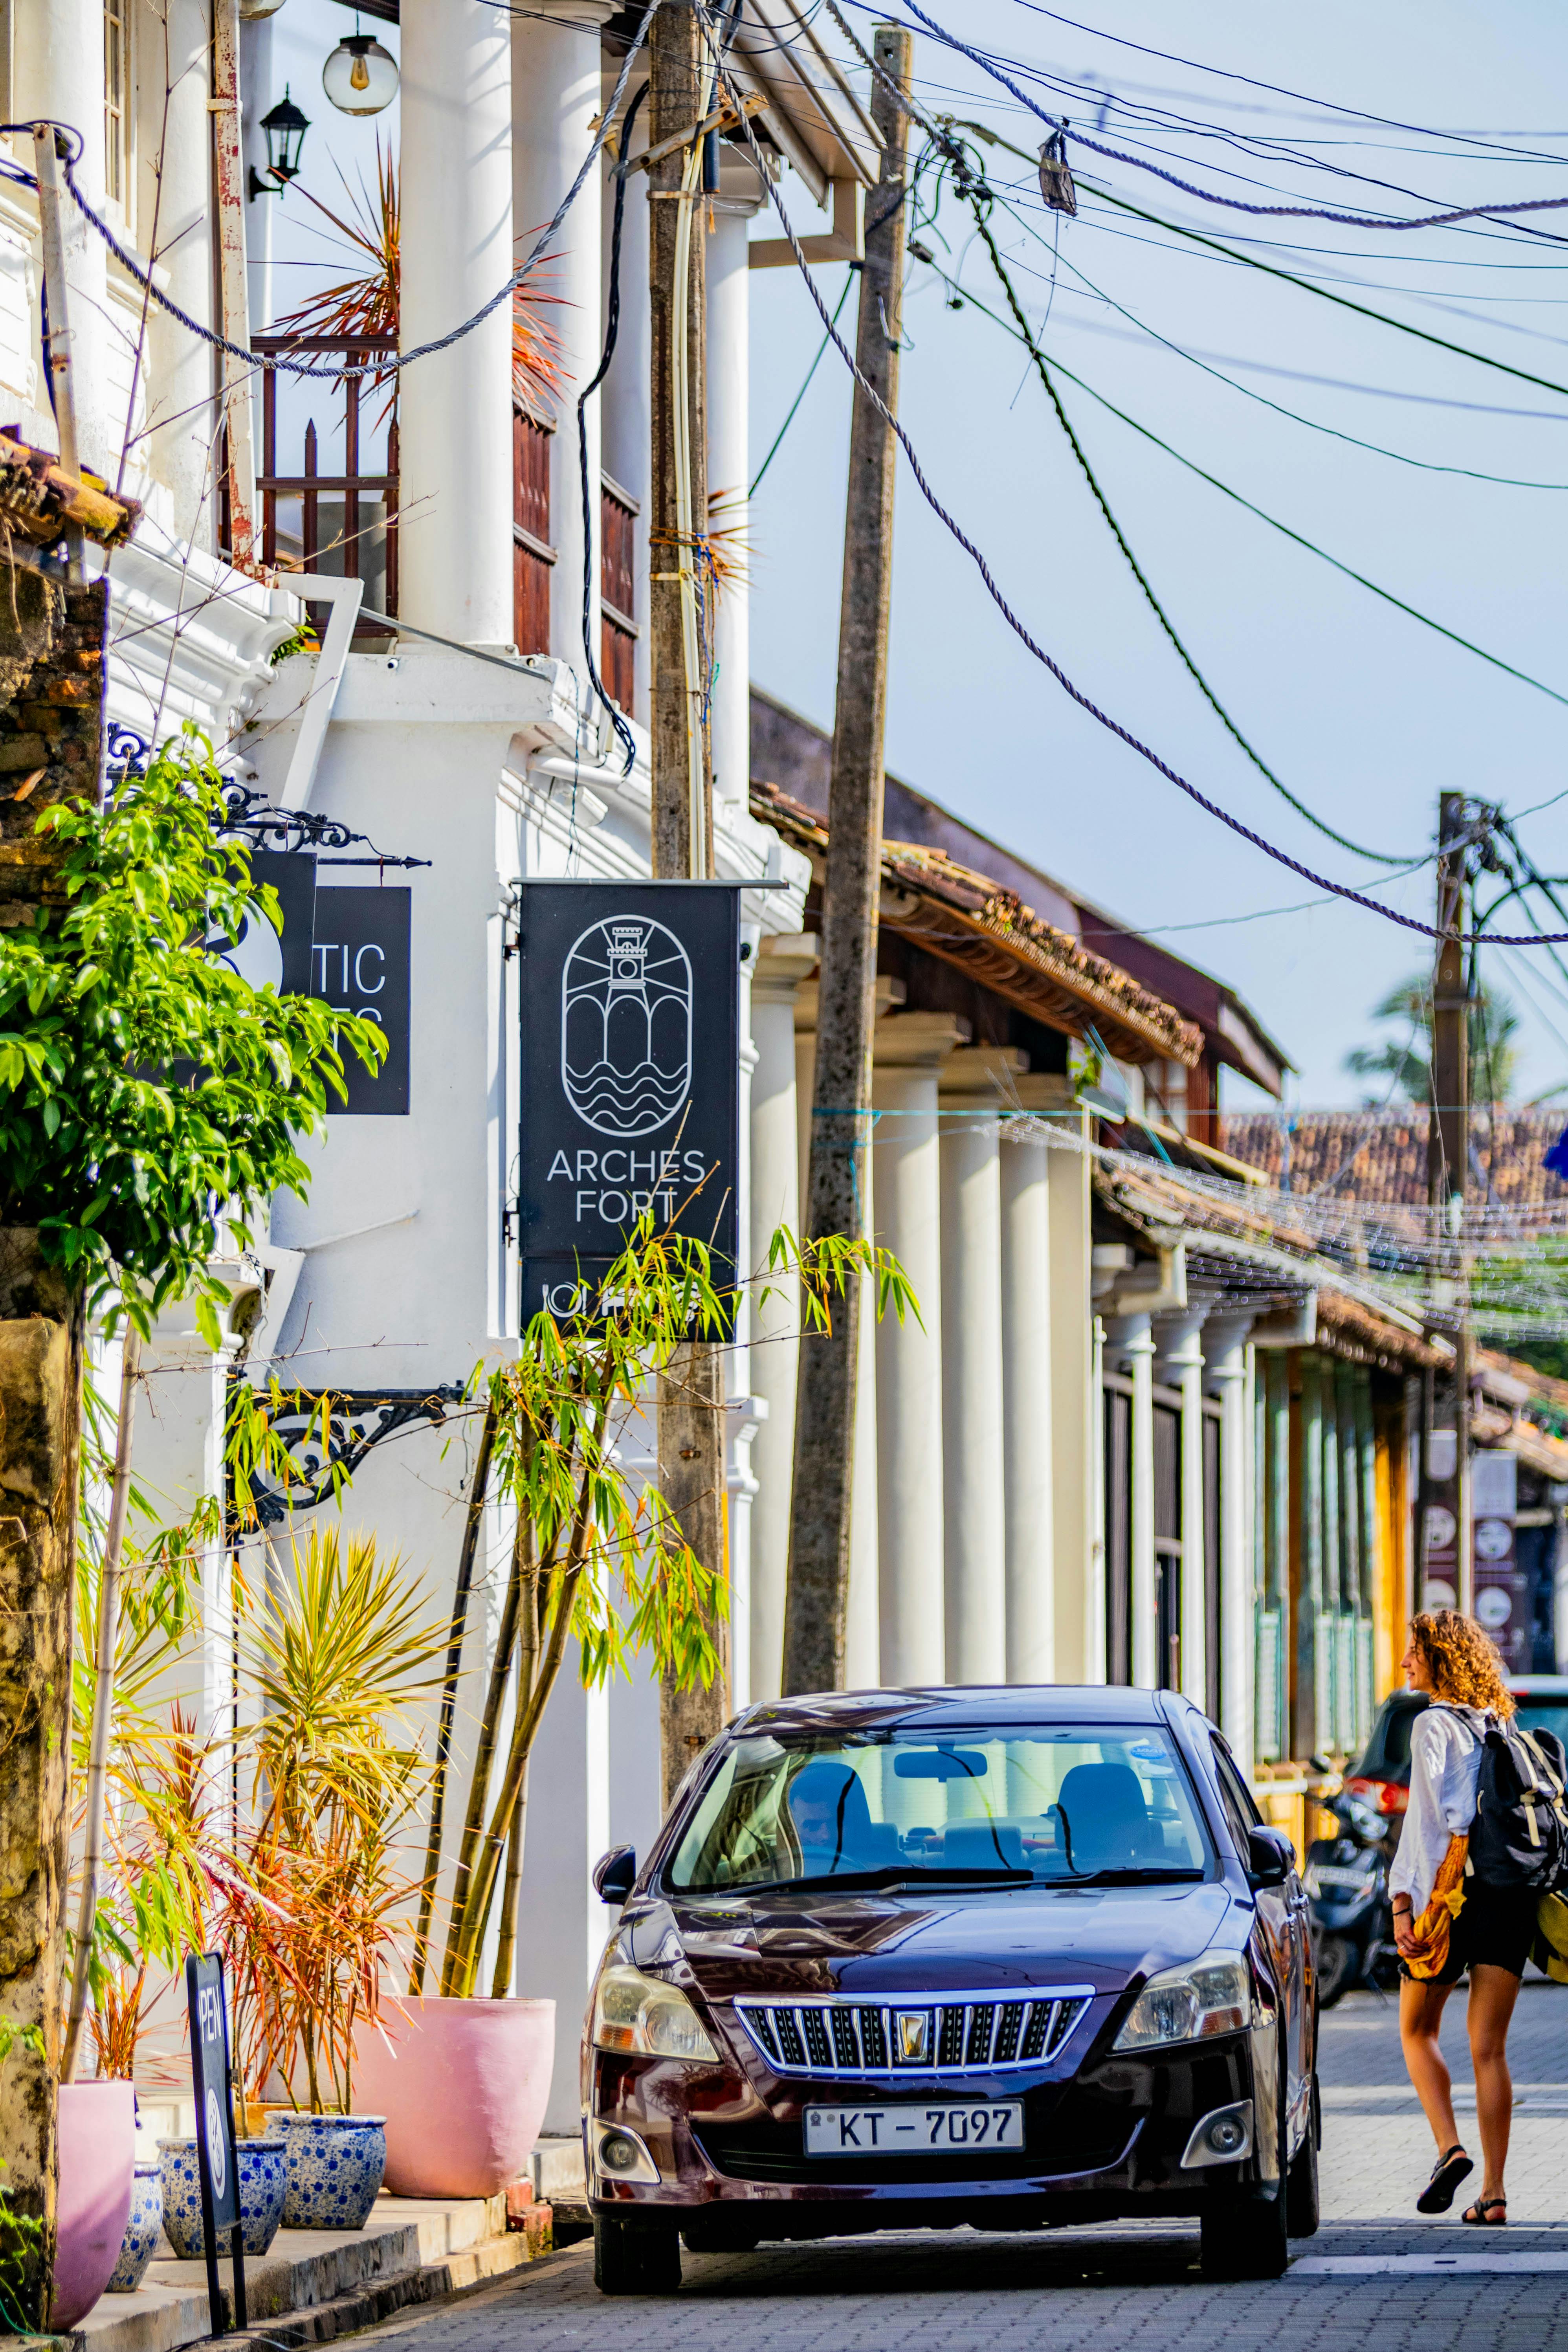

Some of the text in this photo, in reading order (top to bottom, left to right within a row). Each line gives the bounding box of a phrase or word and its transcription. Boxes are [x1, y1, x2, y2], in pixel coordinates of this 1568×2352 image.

[547, 1149, 706, 1183] ARCHES
[576, 1190, 678, 1223] FORT
[199, 1984, 221, 2044] PEN
